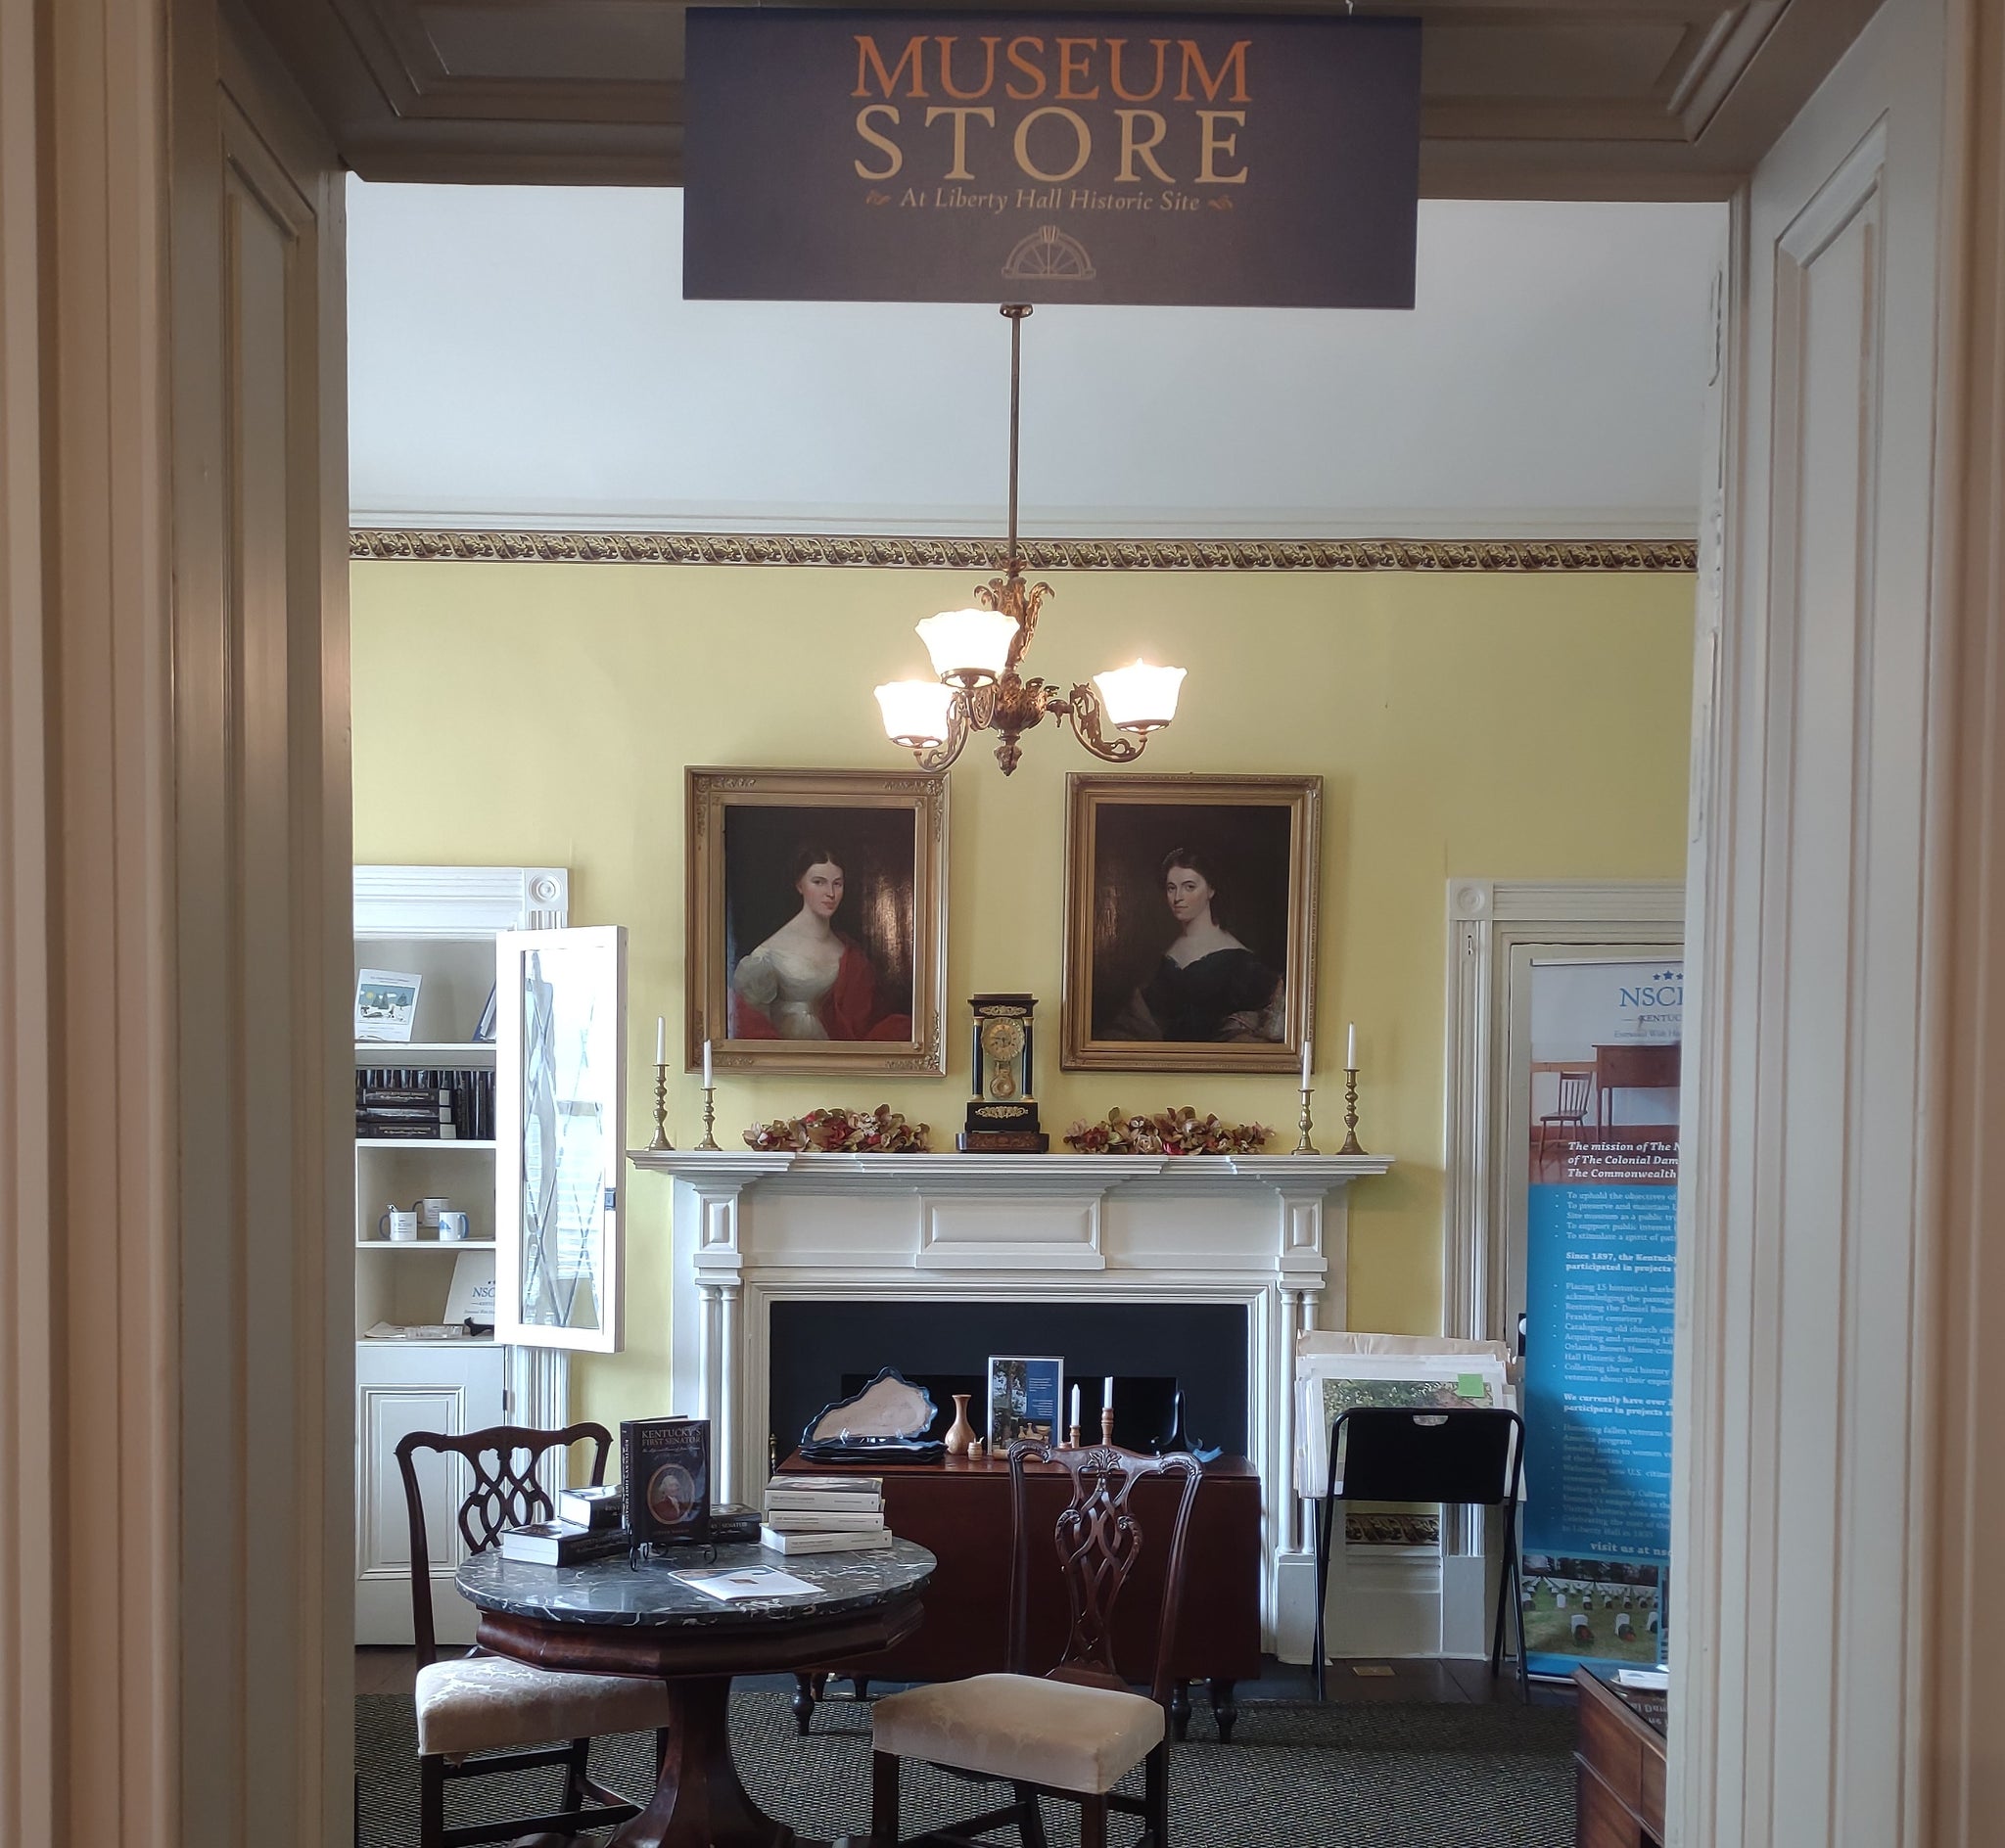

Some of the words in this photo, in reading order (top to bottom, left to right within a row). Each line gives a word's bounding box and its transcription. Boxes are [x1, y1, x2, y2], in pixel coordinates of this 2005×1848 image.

[851, 34, 1252, 102] MUSEUM
[854, 104, 1249, 184] STORE
[901, 188, 926, 207] At
[935, 188, 1007, 214] Liberty
[1016, 188, 1061, 210] Hall
[1069, 189, 1152, 210] Historic
[1160, 190, 1200, 211] Site
[1619, 986, 1683, 1007] NSC
[1568, 1141, 1589, 1151] The
[1591, 1142, 1634, 1151] mission
[1636, 1142, 1649, 1153] of
[1650, 1142, 1672, 1151] The
[1567, 1155, 1580, 1166] of
[1582, 1155, 1603, 1165] The
[1605, 1155, 1651, 1165] Colonial
[1567, 1169, 1588, 1178] The
[1591, 1169, 1677, 1178] Commonwealth
[1592, 1253, 1616, 1262] 1897,
[1566, 1263, 1620, 1271] participated
[1635, 1265, 1671, 1273] projects
[1578, 1395, 1621, 1405] currently
[1623, 1396, 1644, 1405] have
[1563, 1405, 1612, 1414] participate
[1626, 1407, 1662, 1416] projects
[641, 1426, 702, 1439] KENTUCKY'S
[665, 1436, 701, 1445] SENATOR
[1590, 1541, 1617, 1552] visit
[1620, 1545, 1635, 1553] us
